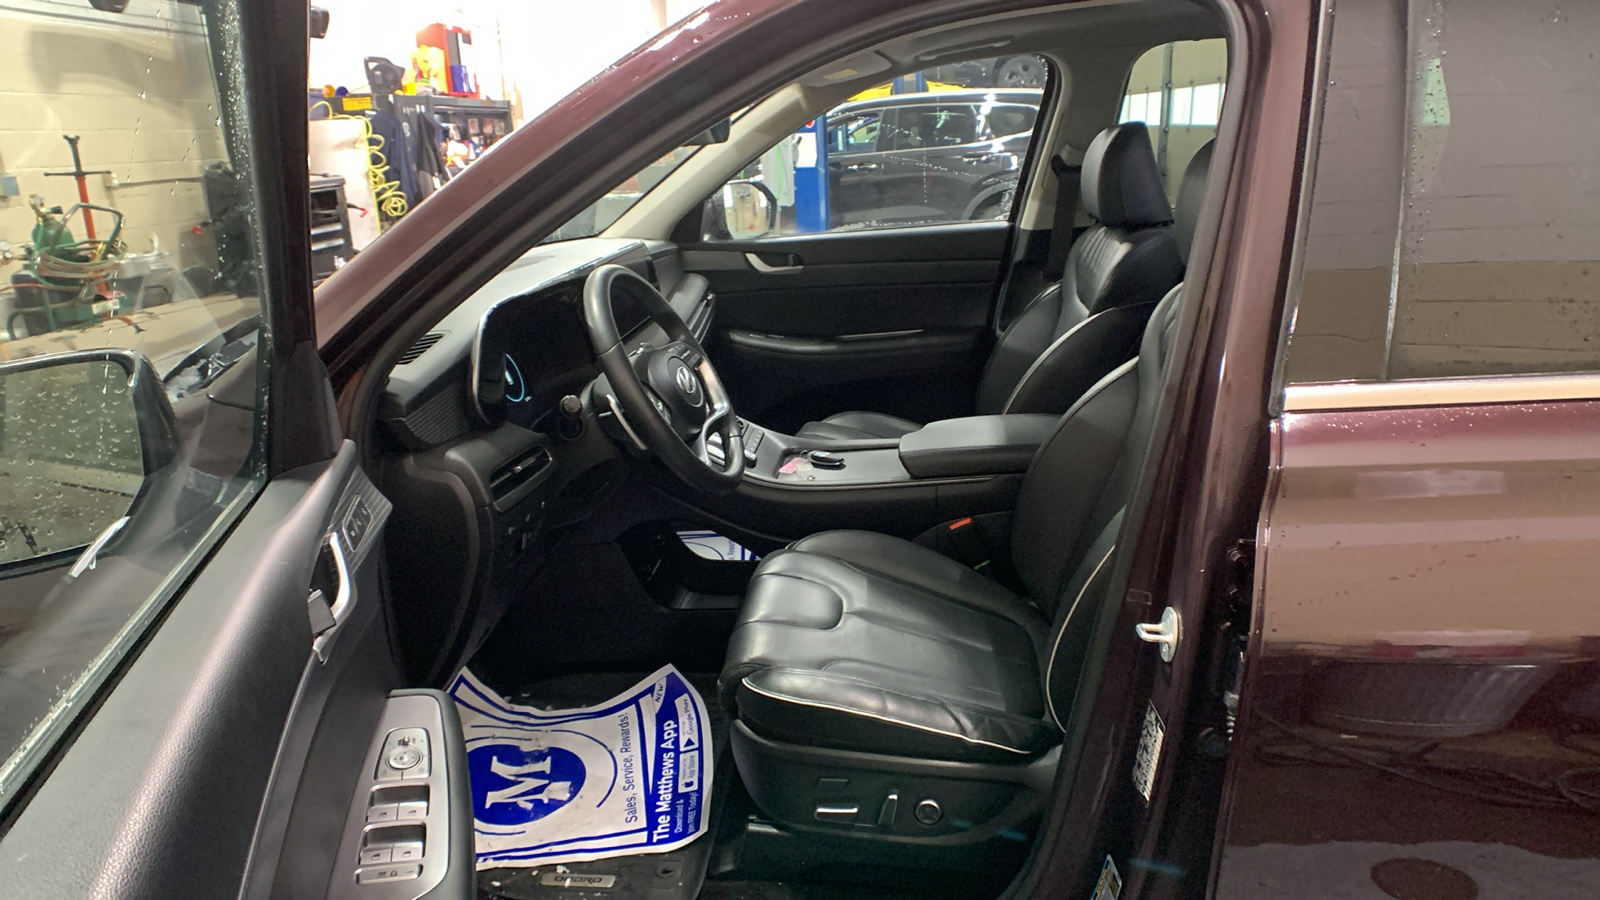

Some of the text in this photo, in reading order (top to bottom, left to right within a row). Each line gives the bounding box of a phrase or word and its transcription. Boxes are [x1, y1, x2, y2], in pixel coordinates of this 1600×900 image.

[655, 683, 664, 702] NEW
[683, 699, 691, 713] Play
[686, 713, 694, 735] Google
[618, 712, 638, 823] Sales, Service, Rewards!
[687, 755, 696, 779] App Store
[485, 755, 551, 809] M
[653, 720, 678, 843] The Matthews App
[688, 791, 699, 810] Today!
[674, 804, 684, 834] Download
[687, 810, 696, 823] FREE
